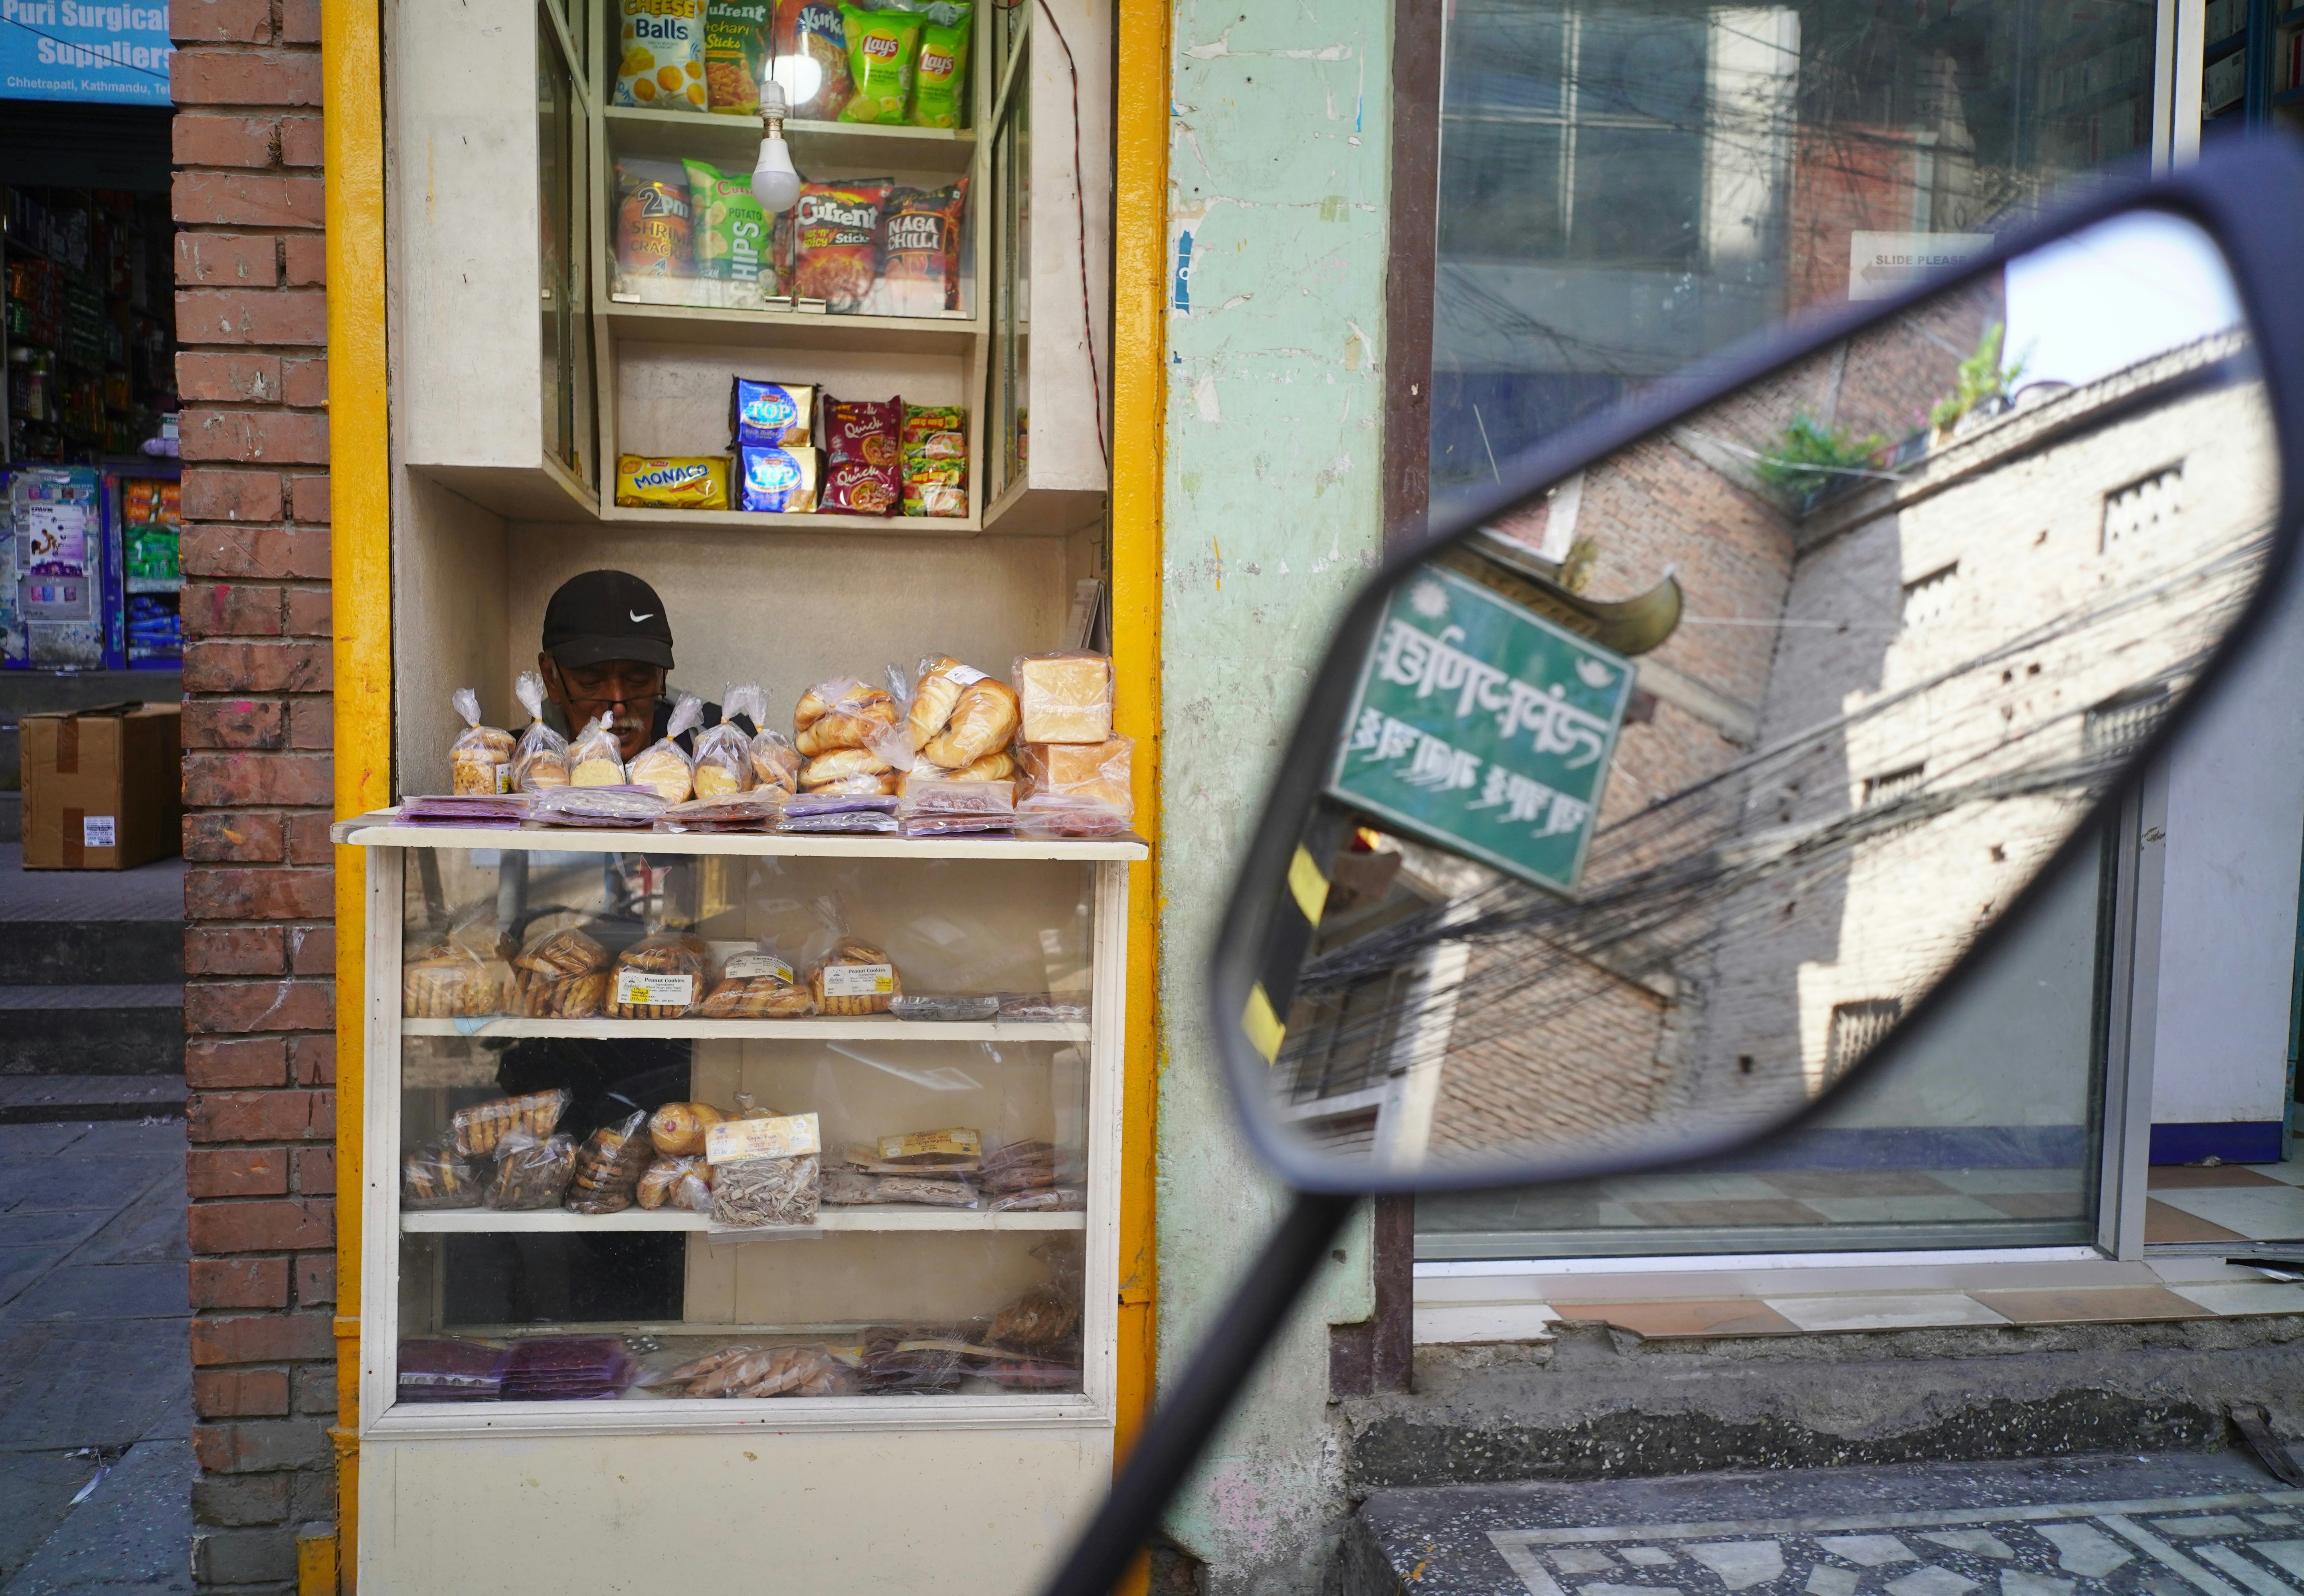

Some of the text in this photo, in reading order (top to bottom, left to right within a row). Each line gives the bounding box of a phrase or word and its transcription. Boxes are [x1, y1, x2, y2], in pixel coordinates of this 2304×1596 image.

[3, 0, 55, 25] Puri
[625, 0, 695, 18] CHEESE
[709, 3, 766, 22] urrent
[635, 19, 689, 40] Balls
[706, 34, 741, 49] Sticks
[864, 36, 898, 57] Lay's
[37, 37, 178, 69] Suppliers
[921, 53, 954, 75] Lay's
[7, 76, 77, 91] Chhetrapati,
[81, 80, 150, 95] Kathmandu,
[729, 207, 762, 221] POTATO
[796, 196, 878, 230] Current
[888, 216, 938, 237] NAGA
[835, 233, 870, 244] Sticks
[888, 232, 939, 251] CHILLI
[730, 221, 760, 296] CHIPS
[1876, 255, 1913, 265] SLIDE
[748, 401, 791, 420] TOP
[845, 416, 883, 439] Quick
[633, 464, 709, 490] MONACO
[752, 466, 794, 482] TOP
[837, 465, 879, 487] Quick
[774, 959, 788, 968] Cherry
